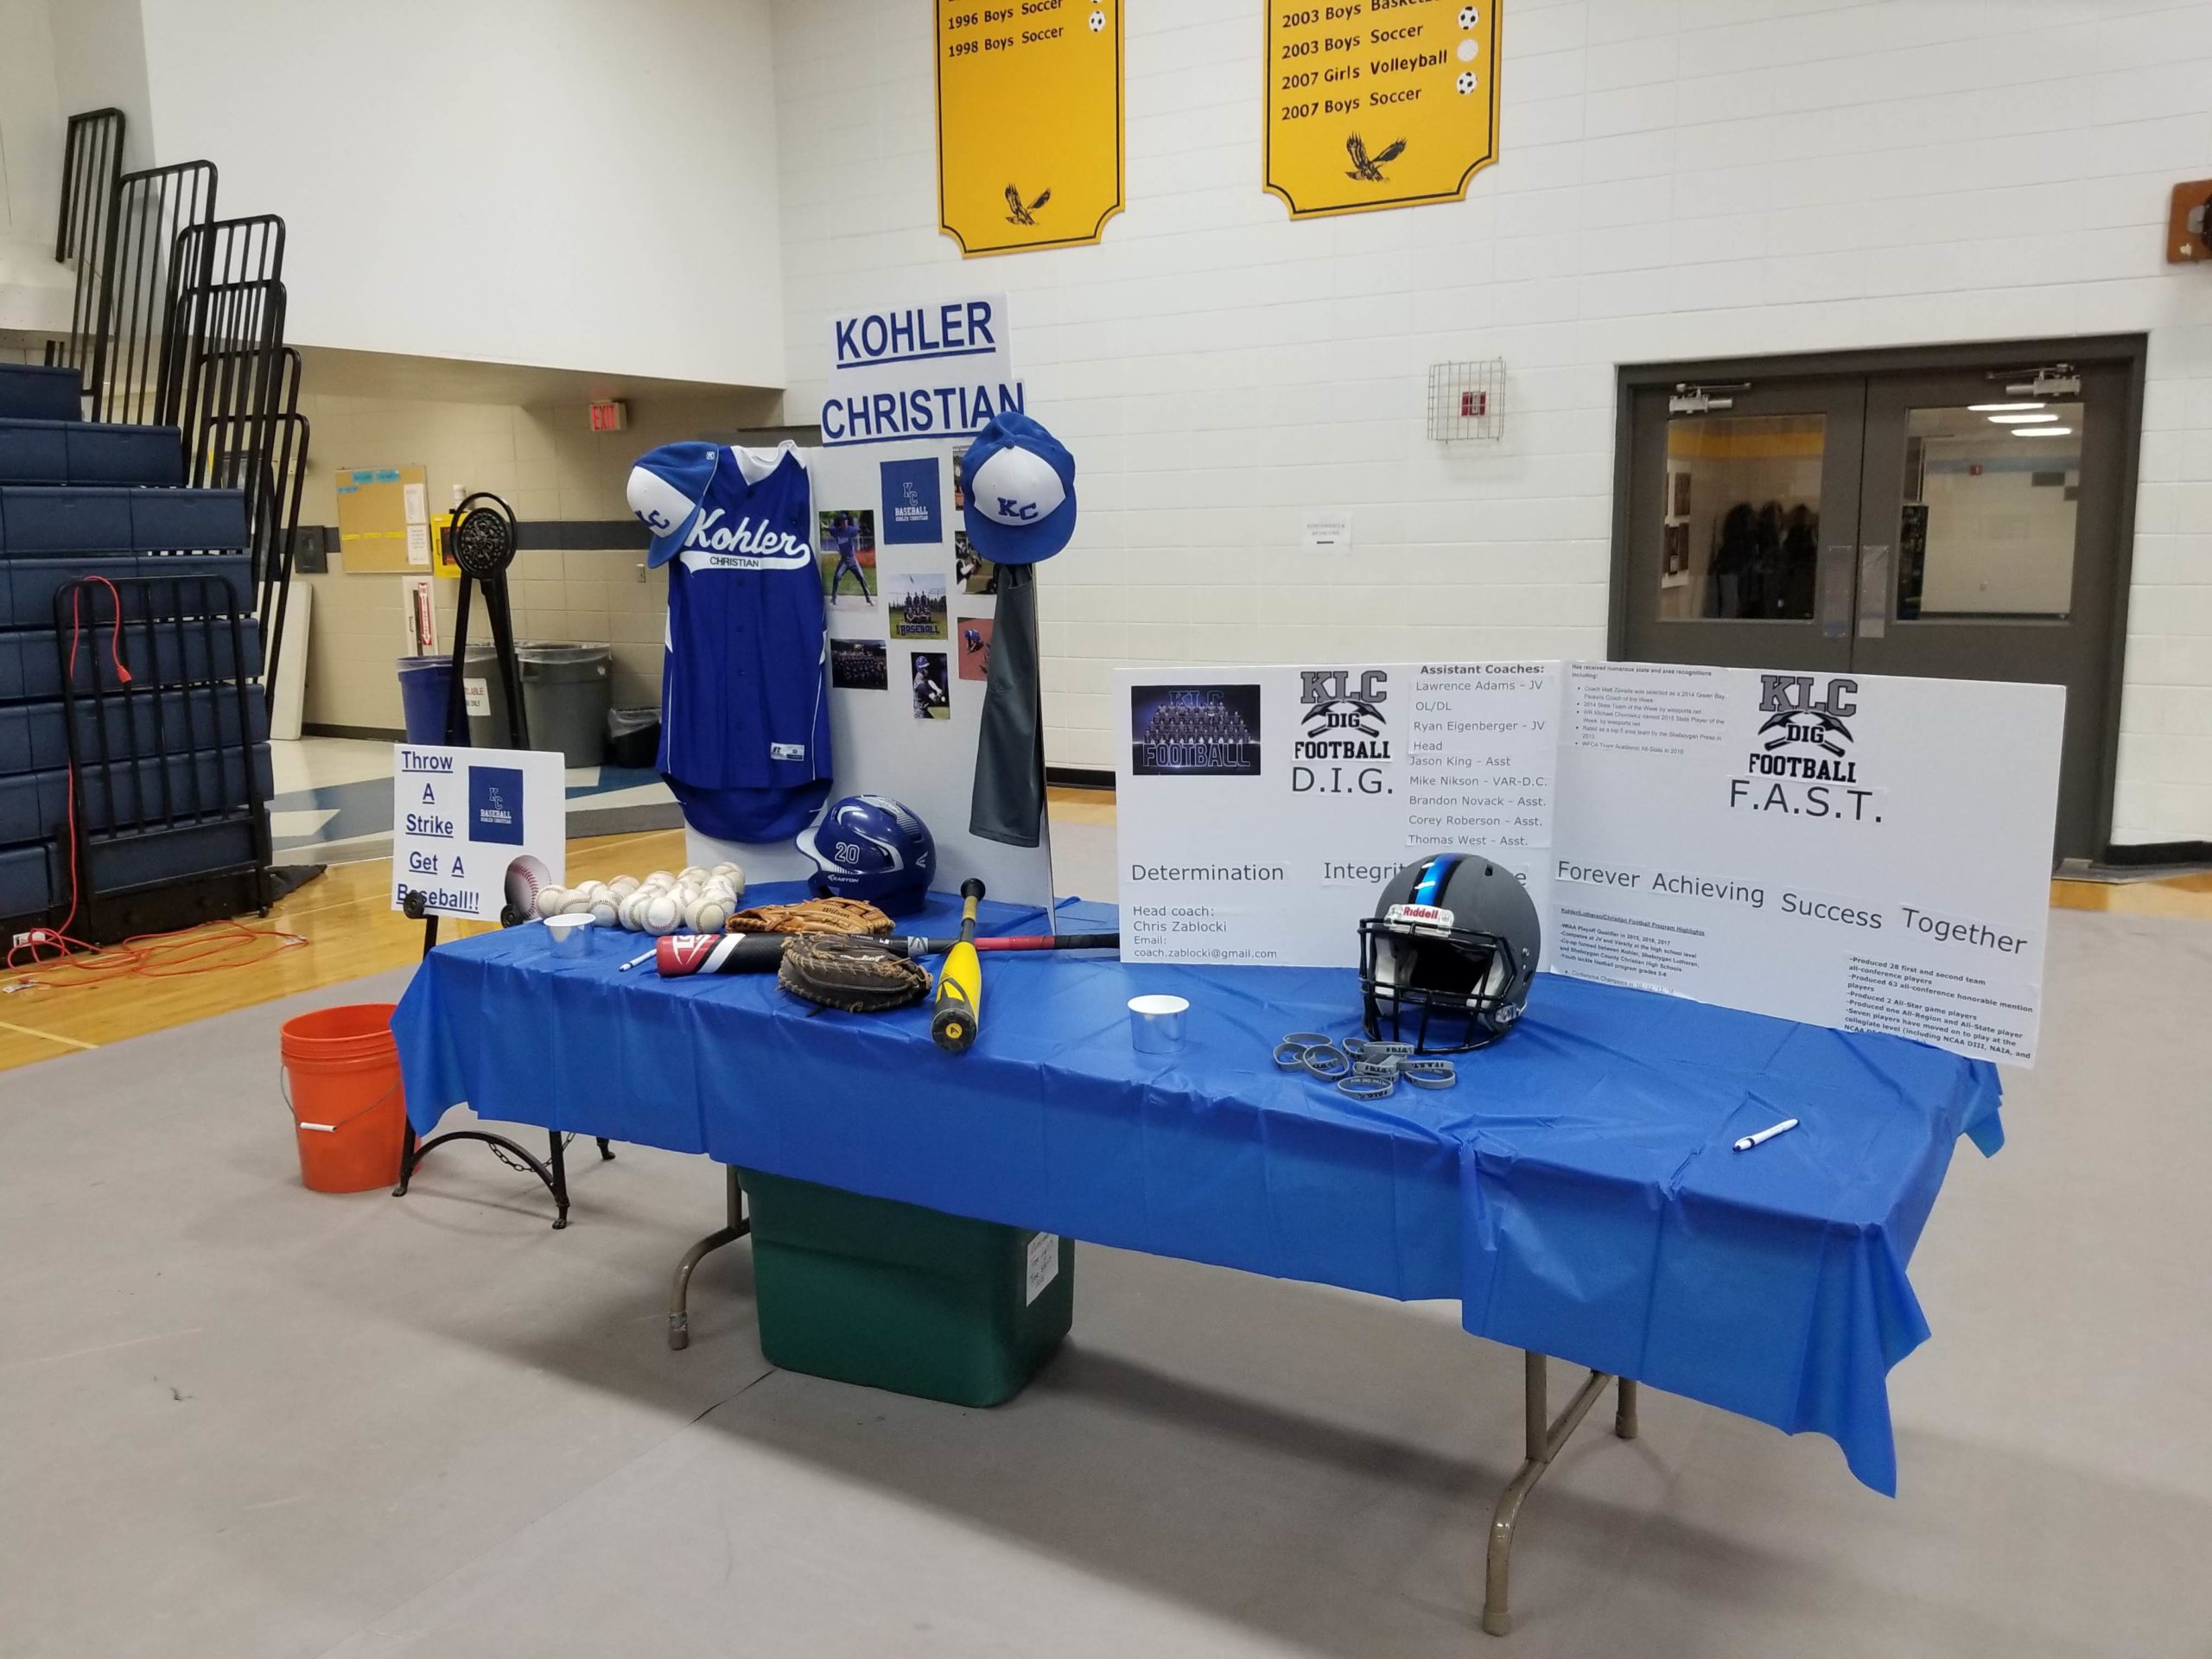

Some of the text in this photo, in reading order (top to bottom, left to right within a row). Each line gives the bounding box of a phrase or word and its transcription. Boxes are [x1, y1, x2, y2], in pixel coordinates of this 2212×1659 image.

[949, 0, 1064, 29] 1996 Boys Soccer
[1282, 10, 1319, 28] 2003
[1325, 4, 1361, 20] Boys
[949, 27, 1064, 57] 1998 Boys Soccer
[1282, 25, 1423, 59] 2003 Boys Soccer
[1282, 49, 1447, 90] 2007 Girls Volleyball
[1281, 89, 1421, 120] 2007 Boys Soccer
[836, 302, 995, 360] KOHLER
[592, 404, 615, 429] EXIT
[823, 382, 1024, 438] CHRISTIAN
[895, 506, 928, 516] BASEBALL
[997, 497, 1038, 520] KC
[684, 508, 805, 556] Kohler
[709, 556, 759, 567] CHRISTIAN
[900, 625, 940, 636] BASEBALL
[1421, 664, 1544, 674] Assistant Coaches:
[1300, 671, 1387, 703] KLC
[1416, 681, 1542, 690] Lawrence Adams JV
[1759, 675, 1858, 717] KLC
[1415, 702, 1452, 712] OL/DL
[1327, 713, 1360, 728] DIG
[1414, 721, 1545, 733] Ryan Eigenberger JV
[1787, 724, 1824, 743] DIG
[1143, 743, 1250, 766] FOOTBALL
[1414, 741, 1442, 750] Head
[402, 751, 452, 769] Throw
[1410, 757, 1510, 767] Jason King Asst
[1293, 767, 1392, 794] D.I.G.
[1410, 776, 1547, 786] Mike Nikson VAR-D.C.
[423, 784, 435, 800] A
[1409, 796, 1546, 806] Brandon Novack Asst.
[1731, 779, 1881, 823] F.A.S.T.
[406, 814, 453, 834] Strike
[480, 809, 512, 819] BASEBALL
[1409, 816, 1542, 826] Corey Roberson Asst.
[1408, 835, 1528, 846] Thomas West Asst.
[410, 851, 464, 874] Get A
[835, 842, 860, 864] 20
[1133, 865, 1283, 880] Determination
[1325, 862, 1404, 882] Integrit
[397, 884, 479, 910] Bseball!!
[823, 907, 849, 918] Wilson
[1134, 906, 1214, 916] Head coach:
[1403, 907, 1438, 919] Riddell
[1559, 861, 2027, 954] Forever Achieving Success Together
[1134, 921, 1226, 931] Chris Zablocki
[1629, 918, 1650, 927] Football
[1652, 923, 1675, 931] Program
[1135, 936, 1166, 944] Email:
[1135, 949, 1277, 959] coach.zablocki@gmail.com
[1849, 965, 1932, 985] all-conference players
[1850, 957, 1887, 968] -Produced
[1936, 972, 1963, 982] second
[1848, 982, 1874, 992] players
[1848, 974, 1886, 986] -Produced
[1900, 983, 1955, 997] all-conference
[1957, 993, 1997, 1006] honorable
[2000, 1002, 2032, 1013] mention
[1847, 991, 1885, 1002] -Produced
[1894, 999, 1922, 1009] All-Star
[1925, 1006, 1946, 1015] game
[1948, 1010, 1977, 1020] players
[1846, 1008, 1871, 1017] -Seven
[1873, 1013, 1900, 1024] players
[1903, 1019, 1920, 1027] have
[1923, 1023, 1948, 1033] moved
[1974, 1033, 1990, 1042] play
[1847, 1000, 1884, 1011] -Produced
[1903, 1009, 1942, 1023] All-Region
[1961, 1021, 1995, 1033] All-State
[1998, 1029, 2023, 1039] player
[1845, 1017, 1880, 1028] collegiate
[1883, 1023, 1900, 1032] level
[1903, 1027, 1941, 1041] (including
[1943, 1036, 1964, 1046] NCAA
[1990, 1046, 2012, 1056] NAIA,
